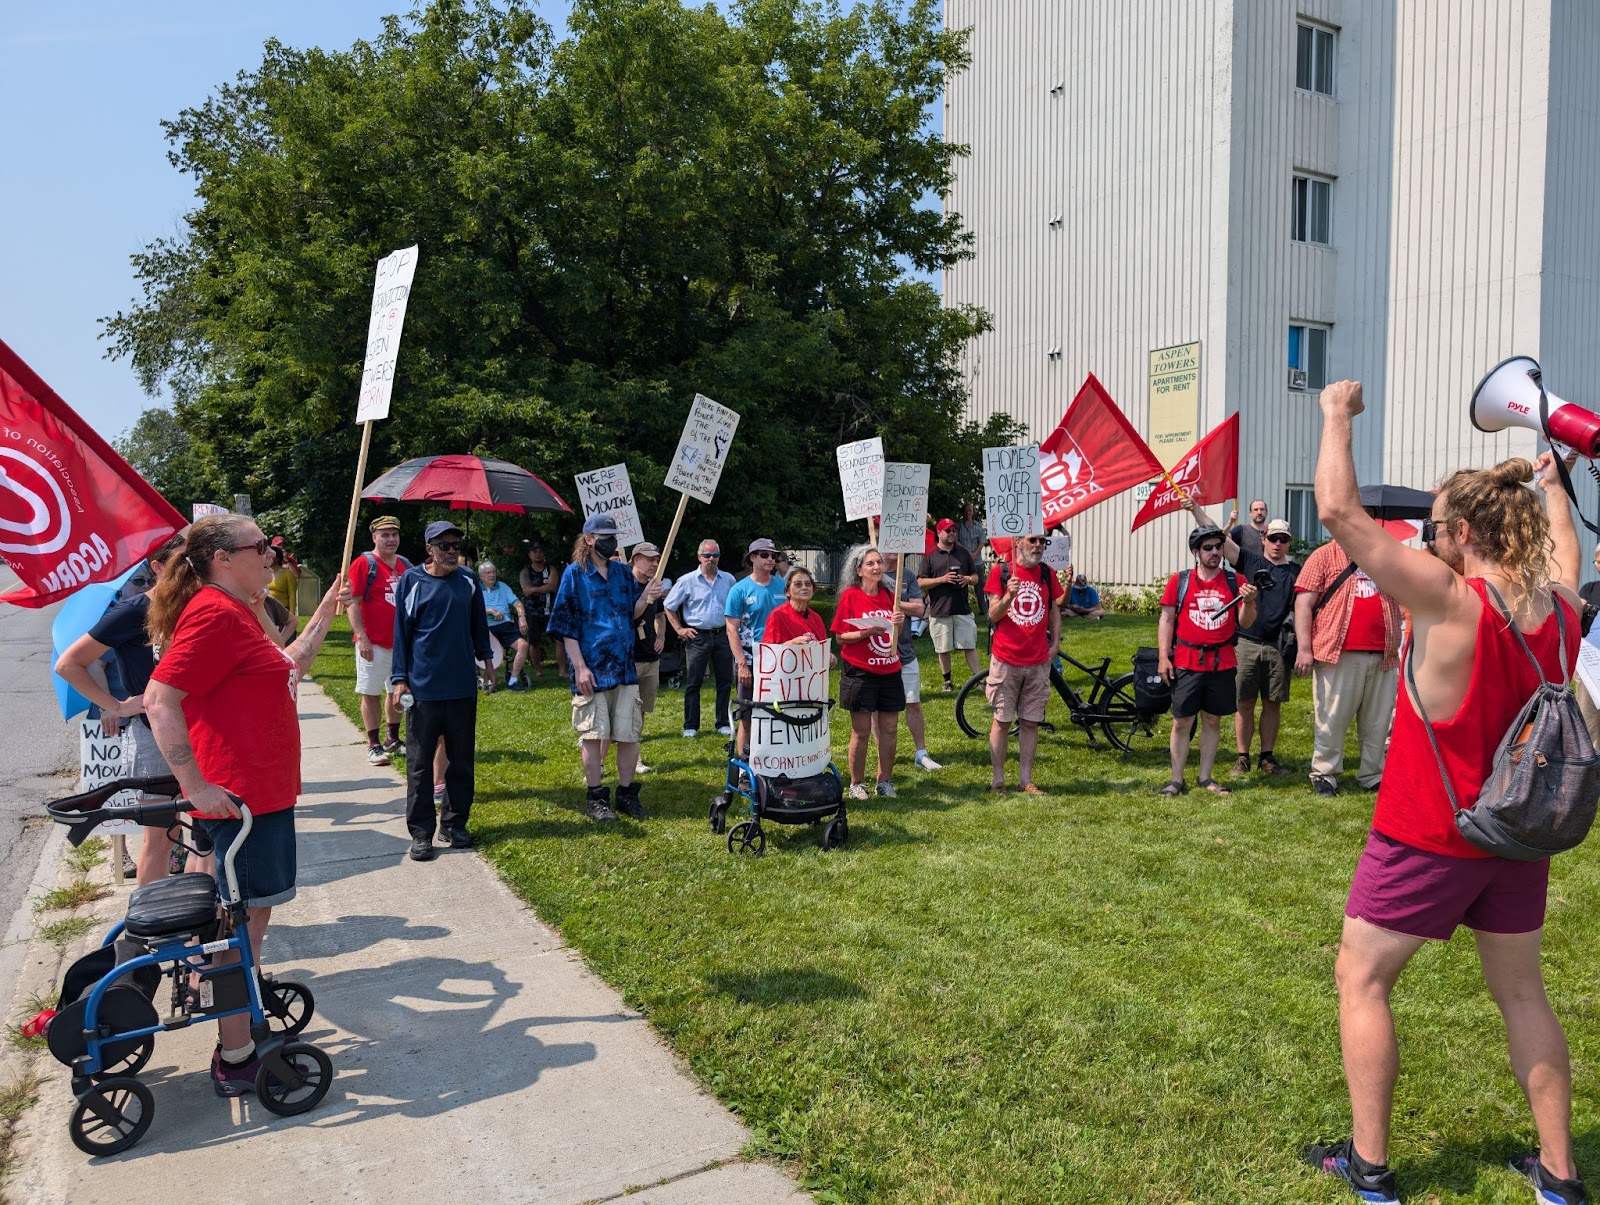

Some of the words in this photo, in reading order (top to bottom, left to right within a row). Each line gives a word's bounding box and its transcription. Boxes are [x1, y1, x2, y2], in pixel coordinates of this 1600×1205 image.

[1157, 346, 1192, 361] ASPEN
[1153, 357, 1196, 373] TOWERS
[1152, 372, 1197, 387] APARTMENTS
[1156, 386, 1170, 394] FOR
[1172, 382, 1191, 392] RENT
[1164, 431, 1192, 439] APPOINTMENT
[840, 441, 872, 459] STOP
[987, 446, 1036, 471] HOMES
[853, 467, 866, 479] AT
[886, 464, 922, 480] STOP
[845, 477, 878, 494] ASPEN
[998, 471, 1030, 493] OVER
[587, 481, 614, 499] NOT
[847, 487, 884, 505] TOWERS
[585, 494, 633, 517] MOVING
[897, 499, 911, 511] AT
[988, 491, 1041, 517] PROFIT
[884, 513, 918, 524] ASPEN
[885, 525, 924, 538] TOWERS
[883, 539, 915, 550] ACORN
[1019, 581, 1040, 590] CORN
